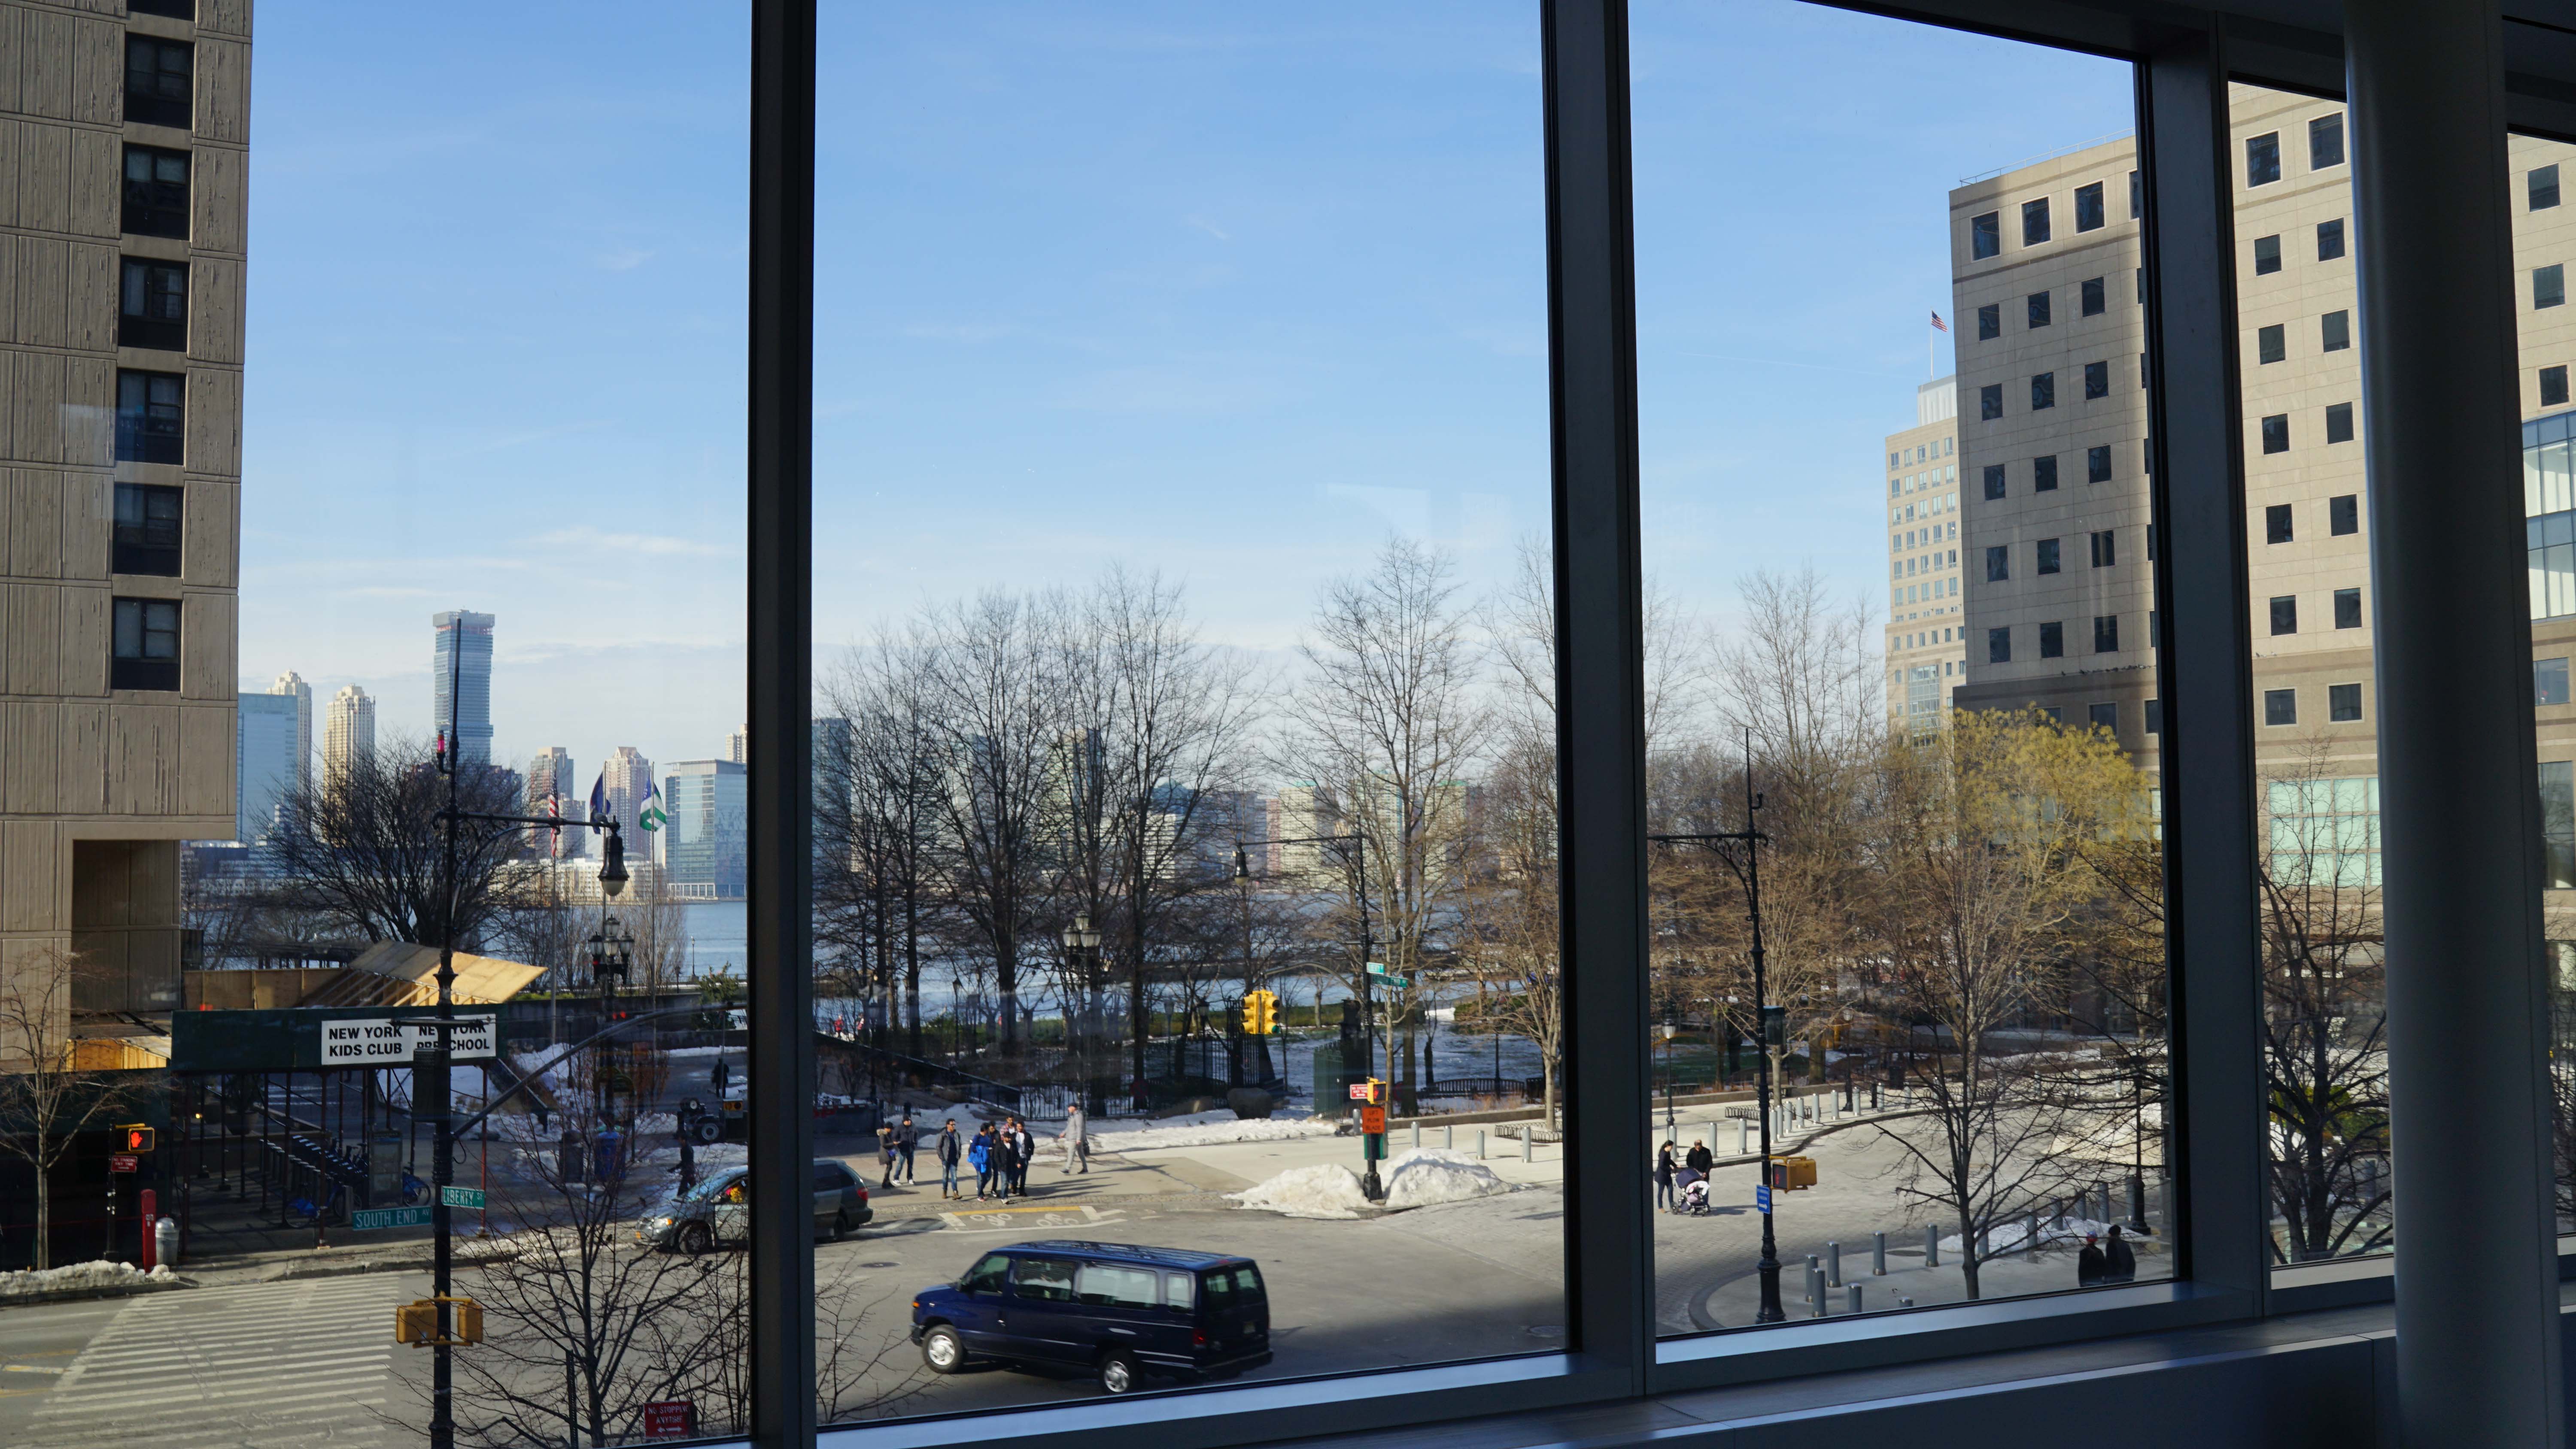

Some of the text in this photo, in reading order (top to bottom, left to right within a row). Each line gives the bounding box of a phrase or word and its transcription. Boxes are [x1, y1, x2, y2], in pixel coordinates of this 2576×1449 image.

[329, 1025, 402, 1040] NEW YORK
[419, 1025, 486, 1036] NE YORK
[329, 1043, 402, 1057] KIDS CLUB
[417, 1039, 490, 1051] PRCHOOL
[443, 1189, 474, 1206] LIBERTY
[356, 1211, 391, 1228] SOUTH
[397, 1210, 417, 1225] END
[659, 1405, 688, 1414] STOPPIN
